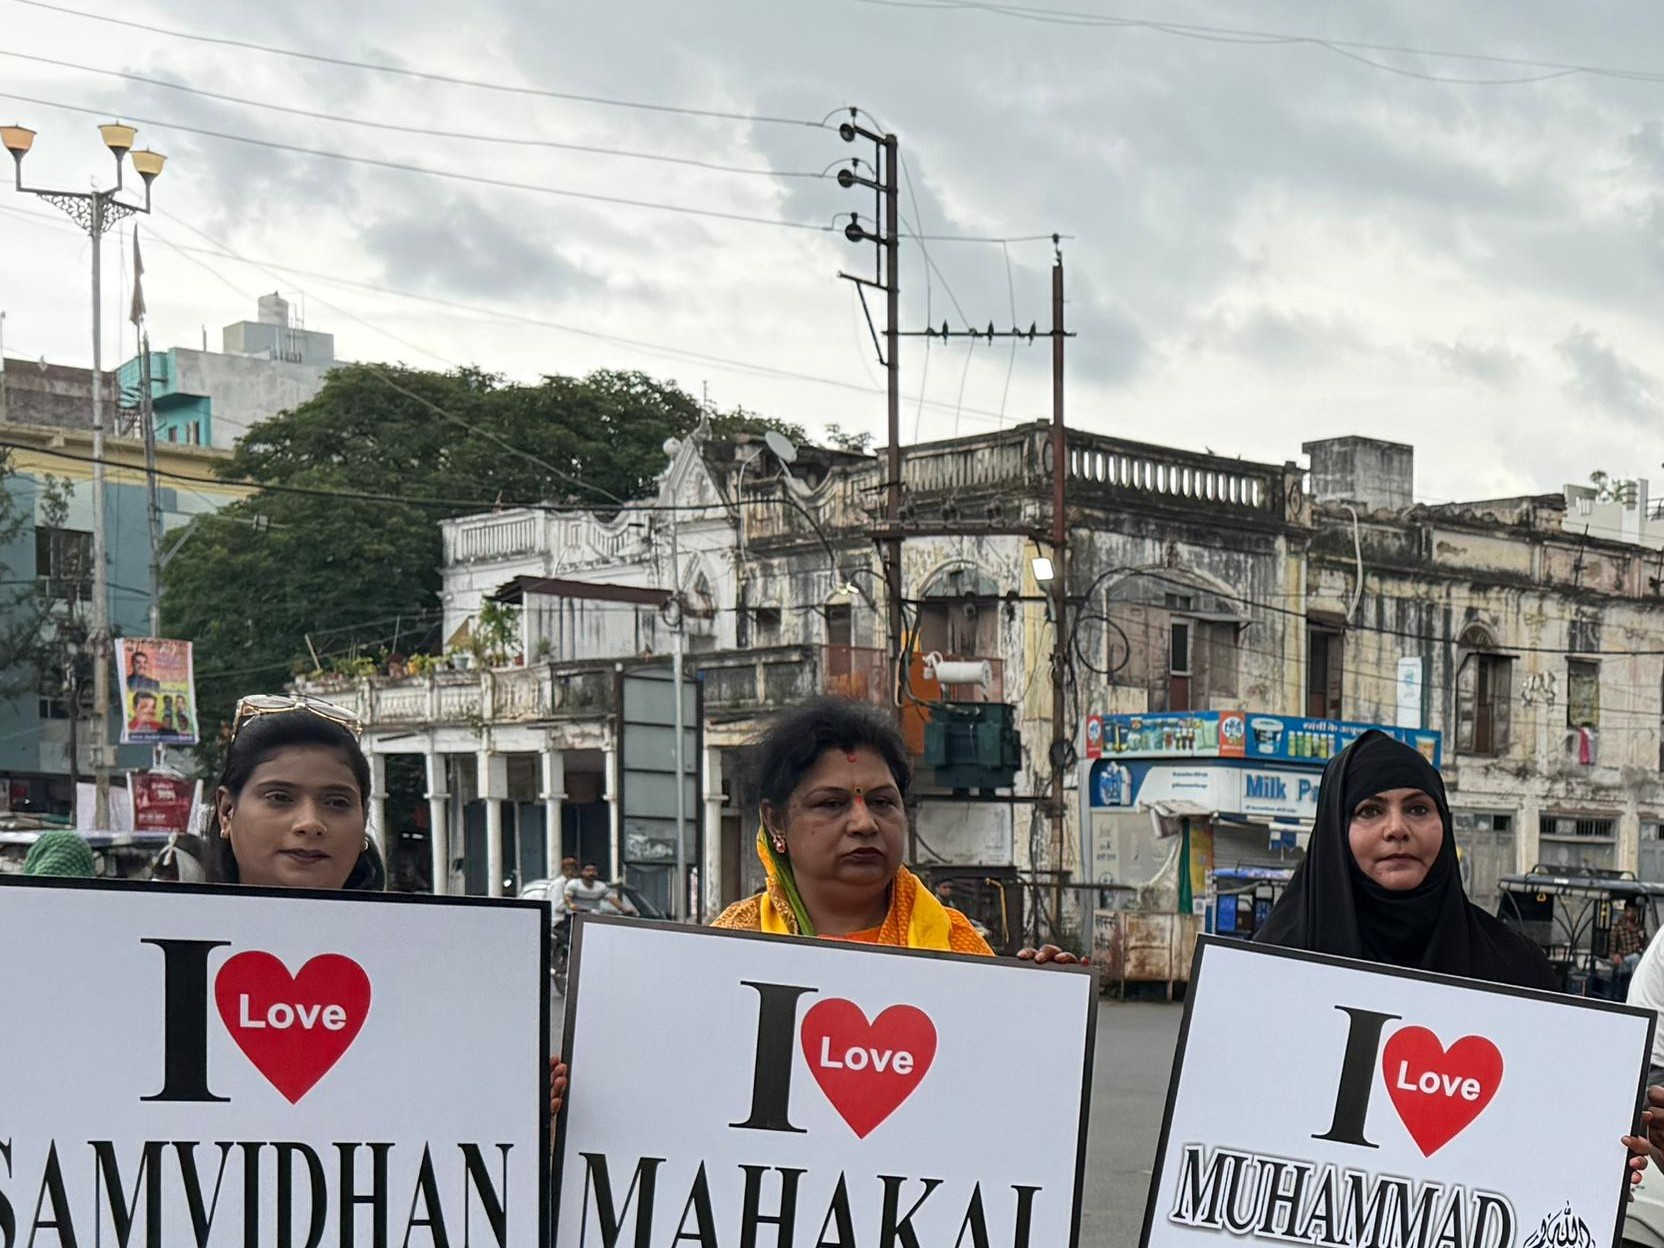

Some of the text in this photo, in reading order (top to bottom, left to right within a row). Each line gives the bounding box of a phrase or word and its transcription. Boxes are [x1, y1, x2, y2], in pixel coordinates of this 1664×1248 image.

[1244, 774, 1287, 800] Milk
[140, 938, 347, 1102] I Love
[728, 980, 914, 1134] I Love
[1311, 1005, 1481, 1149] I Love
